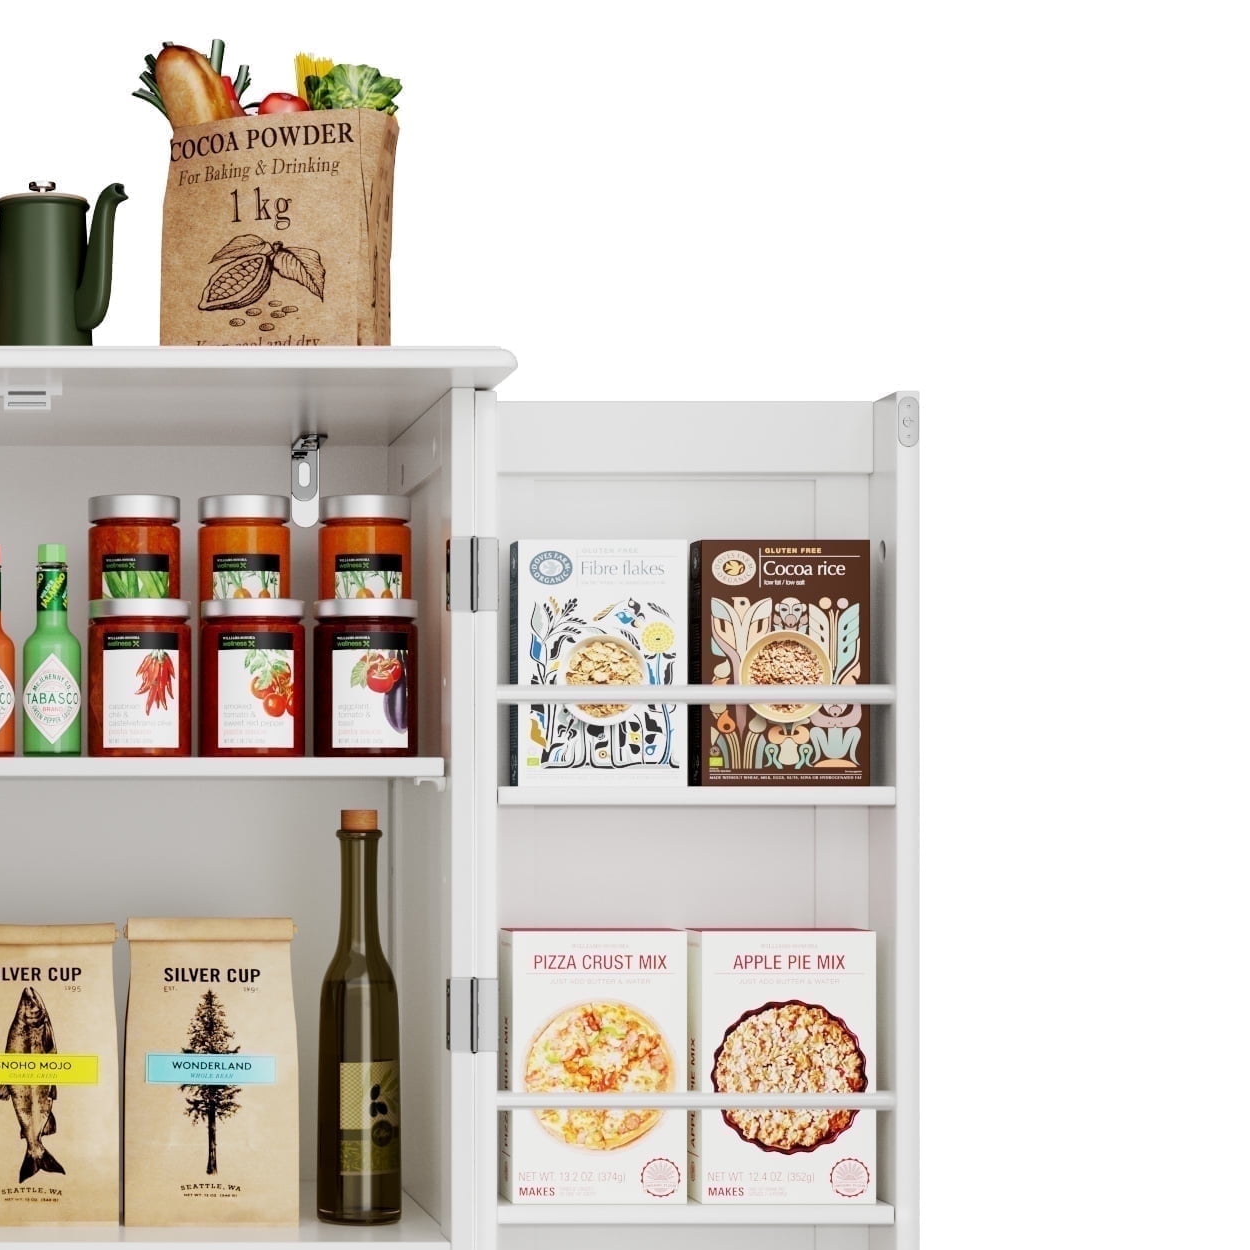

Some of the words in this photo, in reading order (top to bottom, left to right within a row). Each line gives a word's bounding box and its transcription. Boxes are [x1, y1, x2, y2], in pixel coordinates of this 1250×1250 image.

[170, 131, 239, 162] COCOA
[246, 122, 354, 150] POWDER
[179, 170, 200, 186] For
[205, 164, 250, 183] Baking
[256, 160, 266, 176] &
[272, 157, 340, 176] Drinking
[231, 189, 241, 223] 1
[254, 187, 292, 230] kg
[531, 552, 552, 570] DOVES
[581, 560, 618, 576] Fibre
[623, 560, 665, 576] flakes
[763, 560, 813, 576] Cocoa
[817, 560, 846, 576] rice
[534, 570, 570, 584] ORGANIC
[26, 692, 79, 704] TABASCO
[534, 955, 576, 970] PIZZA
[582, 955, 633, 970] CRUST
[639, 955, 667, 970] MIX
[733, 955, 782, 970] APPLE
[788, 955, 811, 970] PIE
[817, 955, 846, 970] MIX
[48, 967, 82, 982] CUP
[164, 967, 221, 982] SILVER
[227, 968, 261, 983] CUP
[40, 1061, 72, 1070] MOJO
[172, 1061, 252, 1071] WONDERLAND
[518, 1171, 537, 1182] NET
[598, 1171, 626, 1184] (374g)
[707, 1171, 726, 1182] NET
[787, 1171, 815, 1184] (352g)
[49, 1188, 63, 1196] WA
[228, 1184, 241, 1192] WA
[519, 1187, 556, 1197] MAKES
[708, 1187, 744, 1197] MAKES
